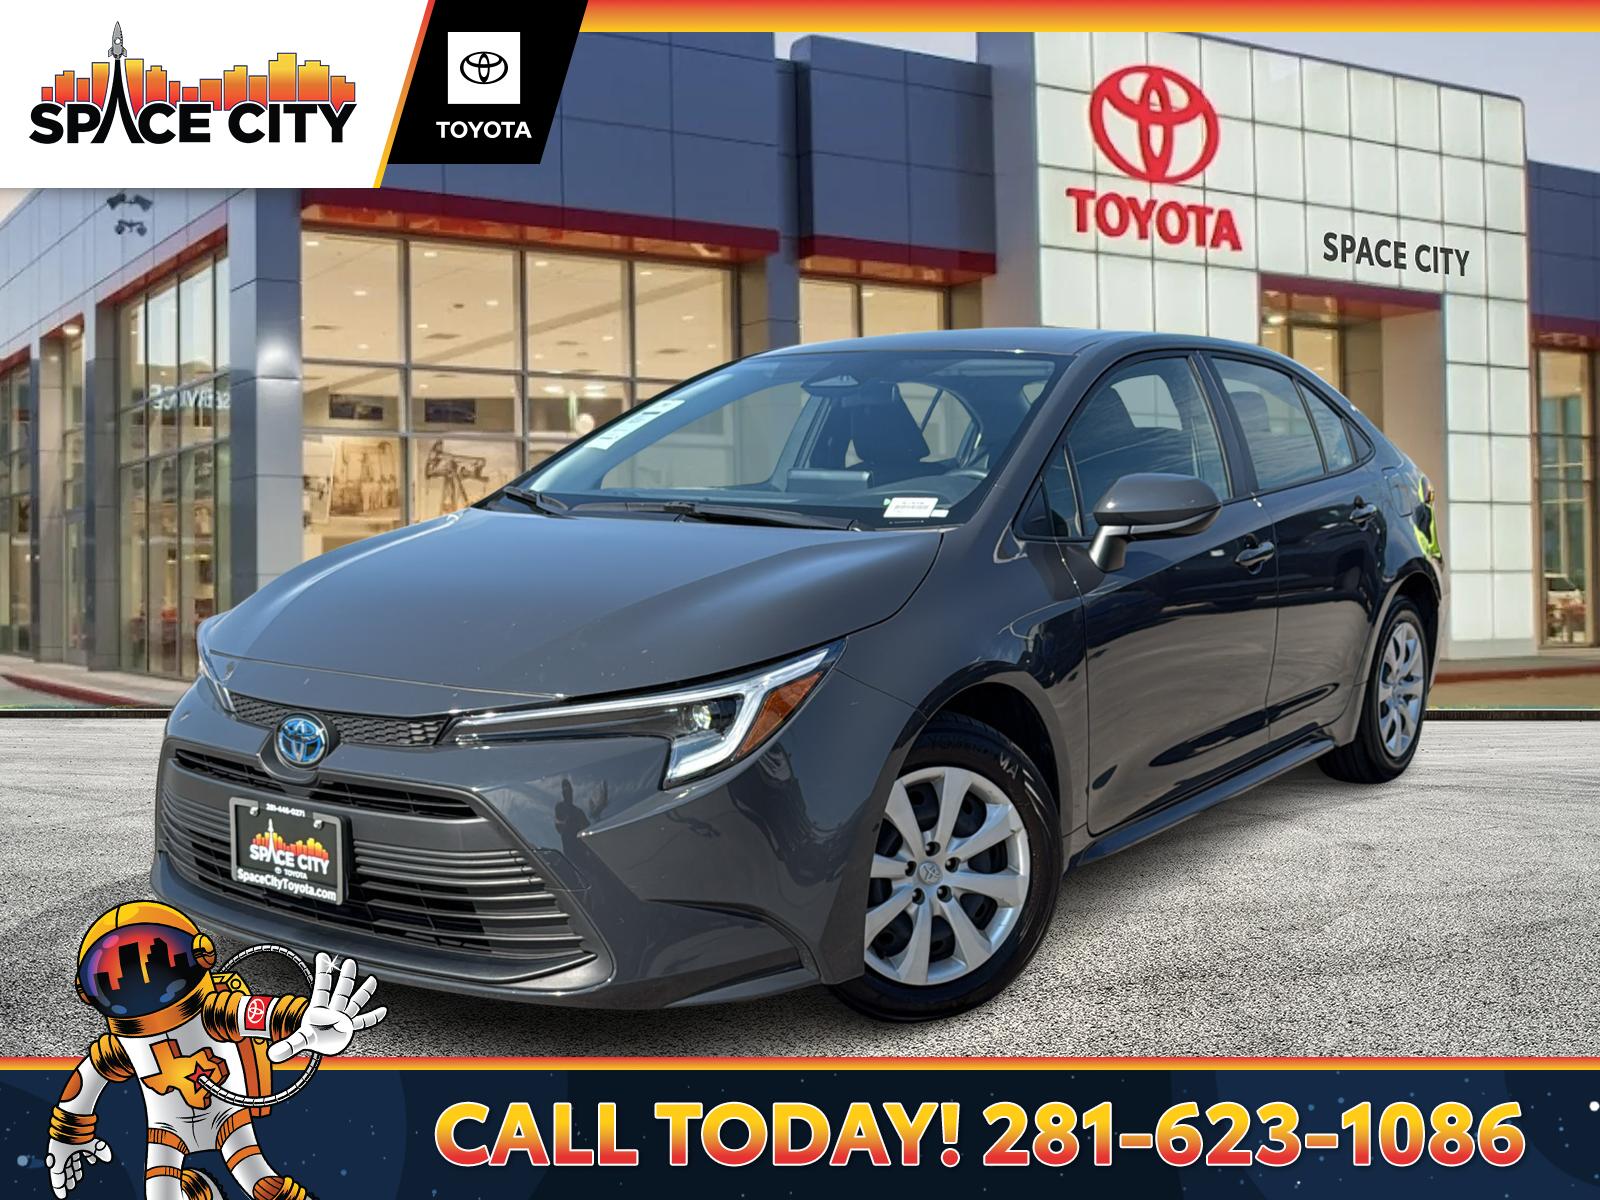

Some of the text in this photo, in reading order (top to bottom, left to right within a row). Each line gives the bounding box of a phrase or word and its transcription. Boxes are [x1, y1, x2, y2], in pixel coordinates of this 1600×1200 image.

[1066, 187, 1242, 252] TOYOTA
[1322, 231, 1470, 277] SPACE CITY
[283, 868, 308, 881] TOYOTA
[297, 852, 330, 875] CITY
[237, 868, 337, 902] SpaceCityToyota.com
